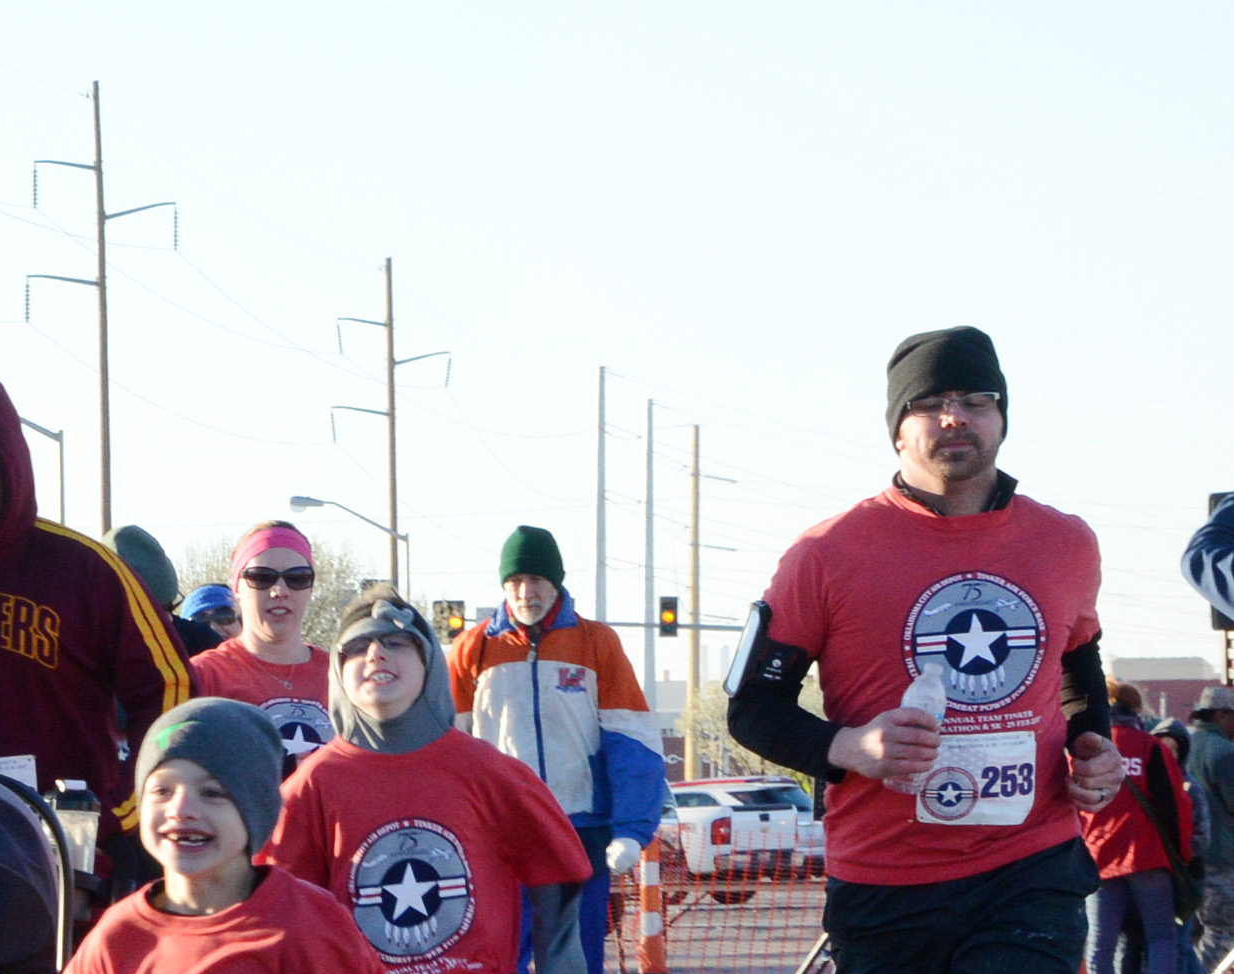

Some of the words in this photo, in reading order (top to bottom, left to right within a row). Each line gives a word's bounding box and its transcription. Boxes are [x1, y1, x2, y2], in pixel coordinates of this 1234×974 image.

[1018, 590, 1039, 613] FORCE
[945, 700, 978, 711] OMBAT
[979, 698, 1012, 712] POWER
[1024, 649, 1045, 686] AMERICA
[942, 716, 975, 725] NNUAL
[980, 762, 1034, 799] 253
